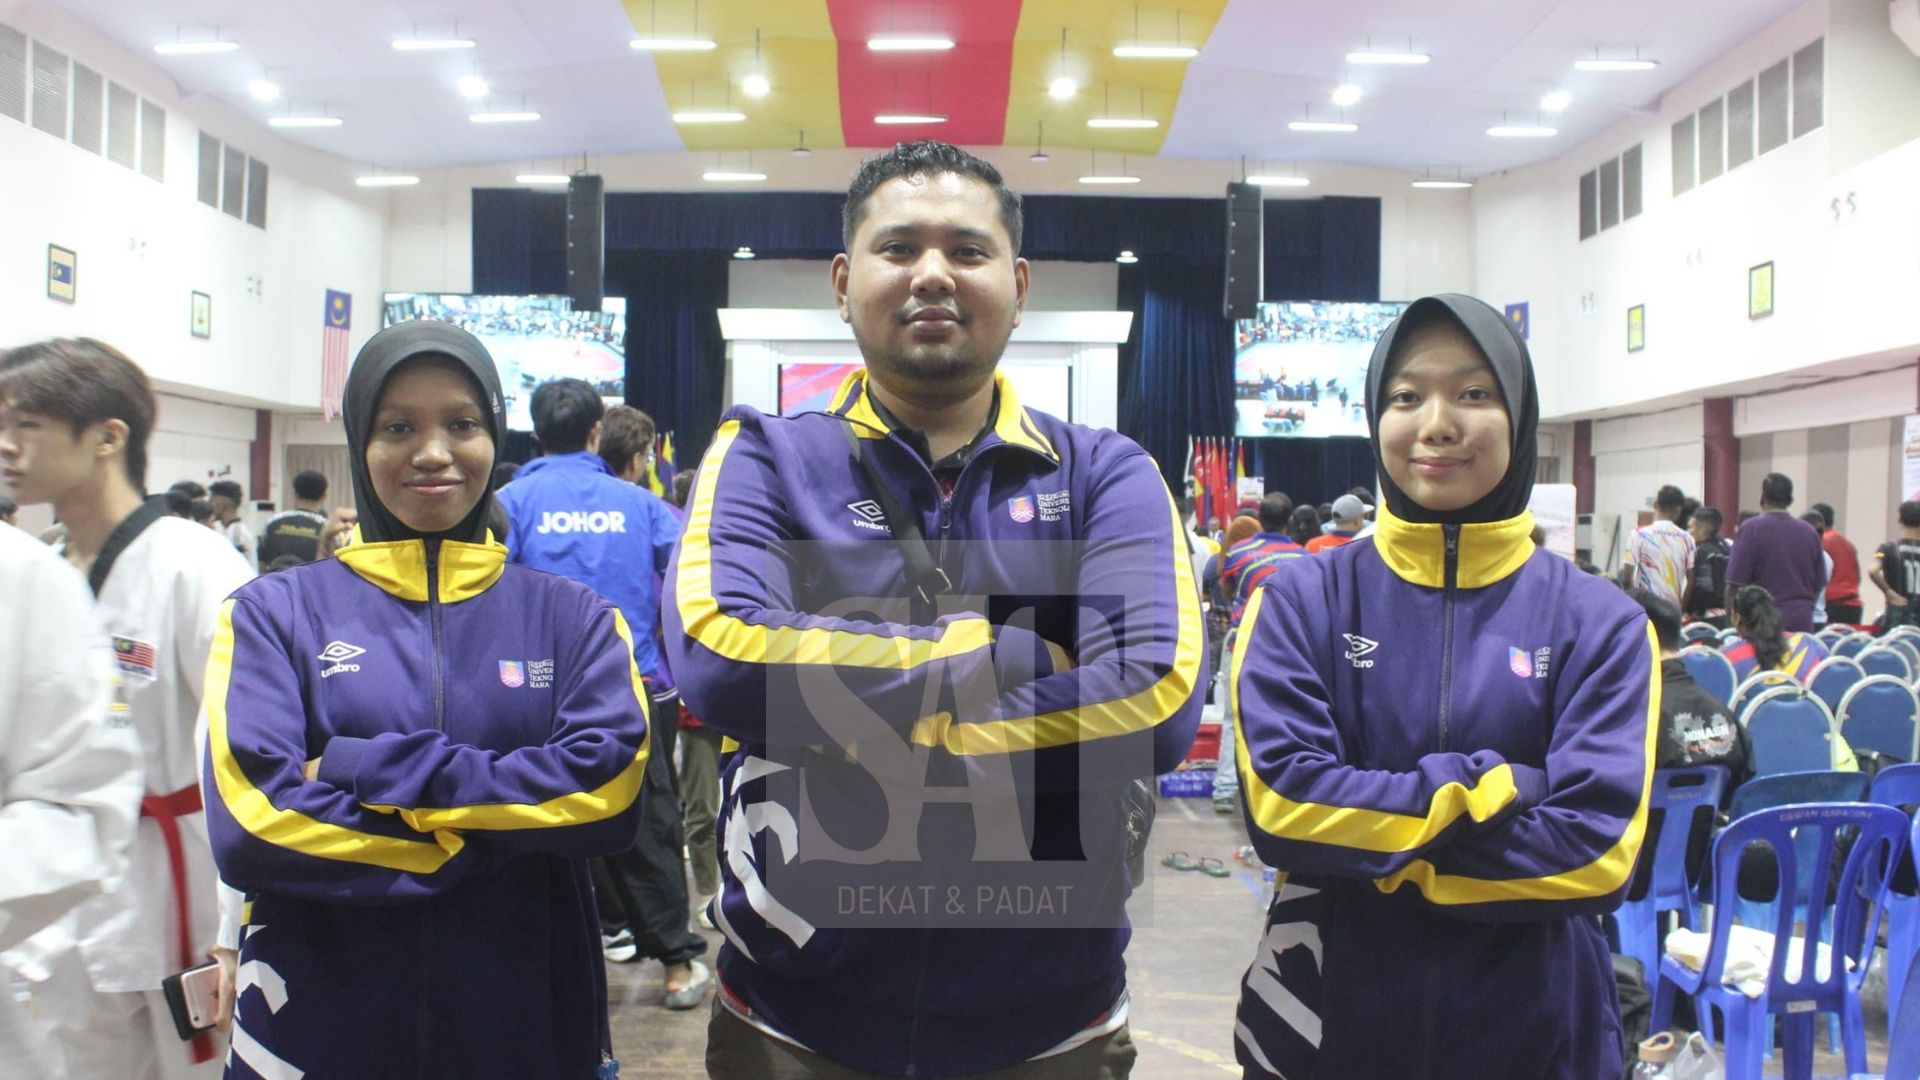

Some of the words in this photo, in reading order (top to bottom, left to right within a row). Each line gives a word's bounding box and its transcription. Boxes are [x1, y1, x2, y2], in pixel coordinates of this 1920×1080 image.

[537, 511, 627, 534] JOHOR
[1345, 651, 1374, 668] ubro
[321, 663, 360, 678] umbro
